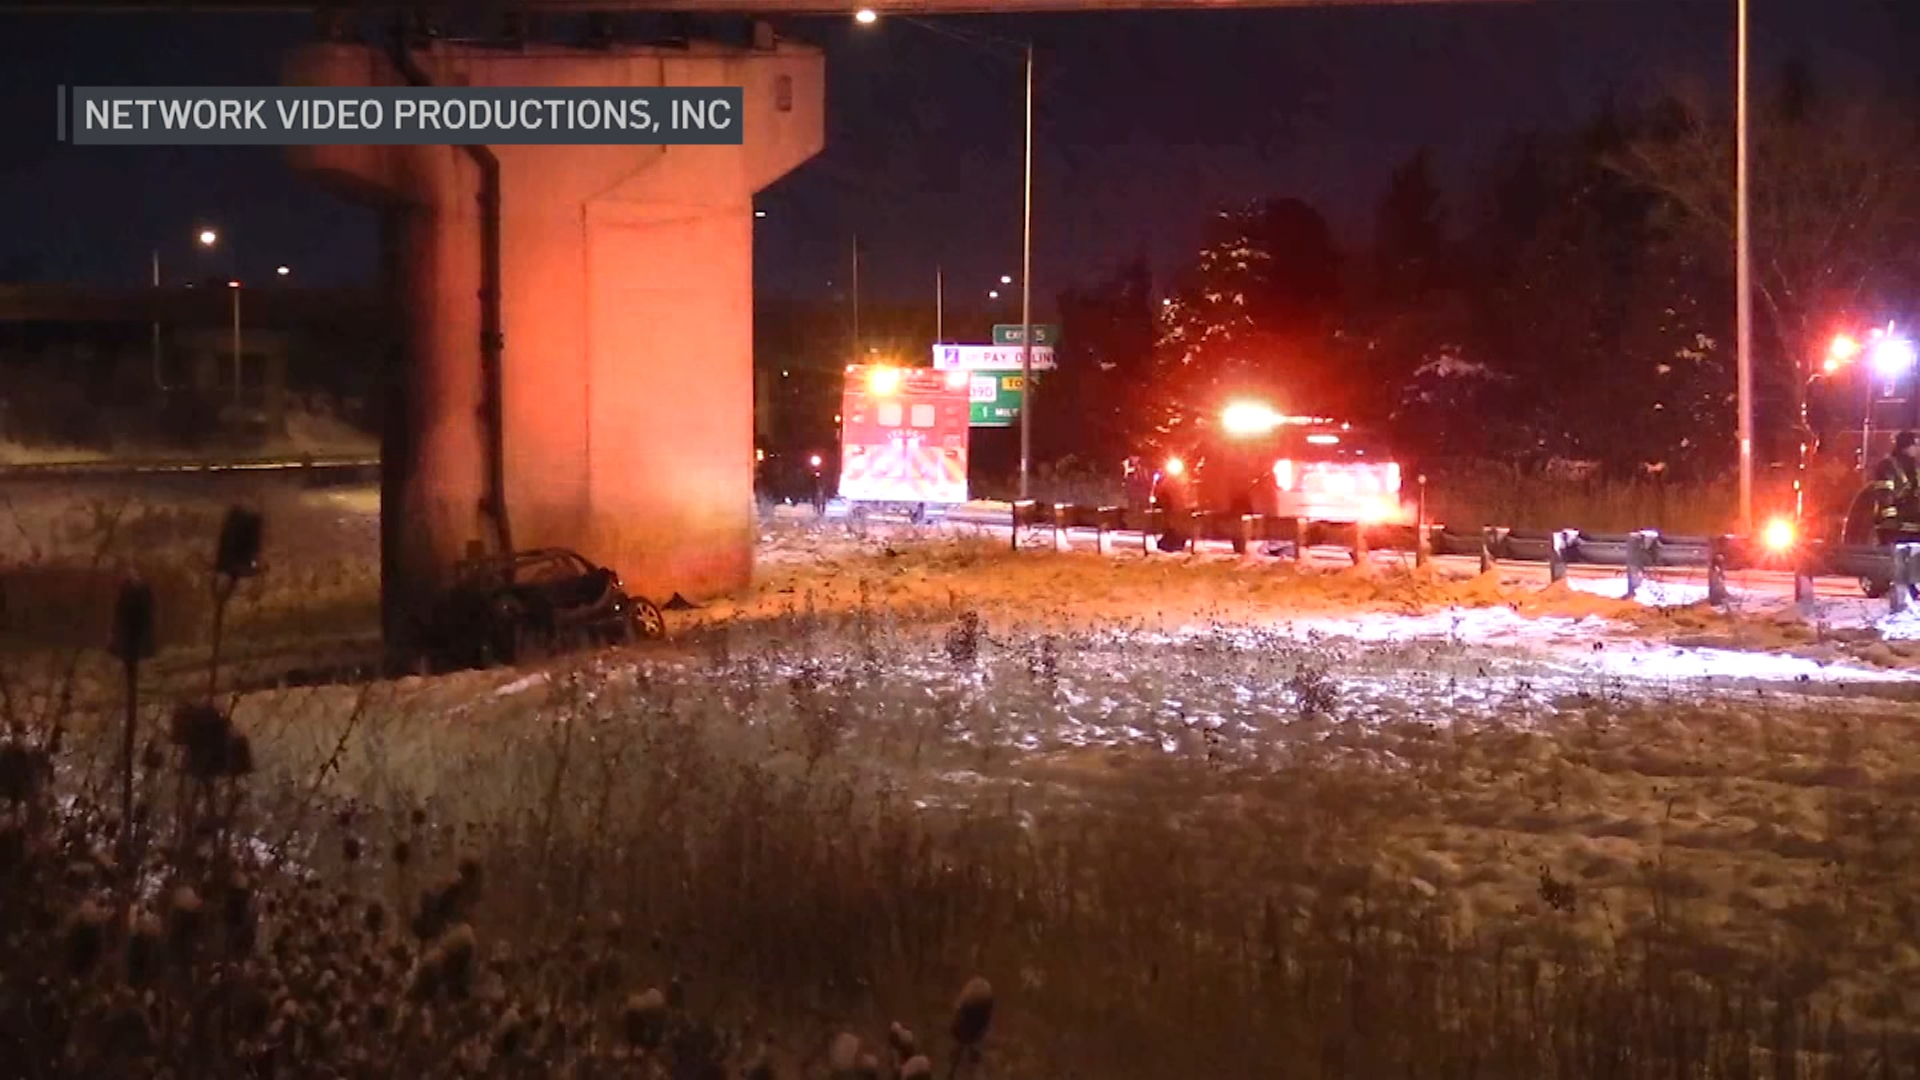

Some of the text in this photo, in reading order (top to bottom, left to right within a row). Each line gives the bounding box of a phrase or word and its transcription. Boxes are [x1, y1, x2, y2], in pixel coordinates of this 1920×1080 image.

[1005, 330, 1025, 340] EXI
[983, 352, 1008, 363] PAY
[1015, 352, 1056, 363] OLIN
